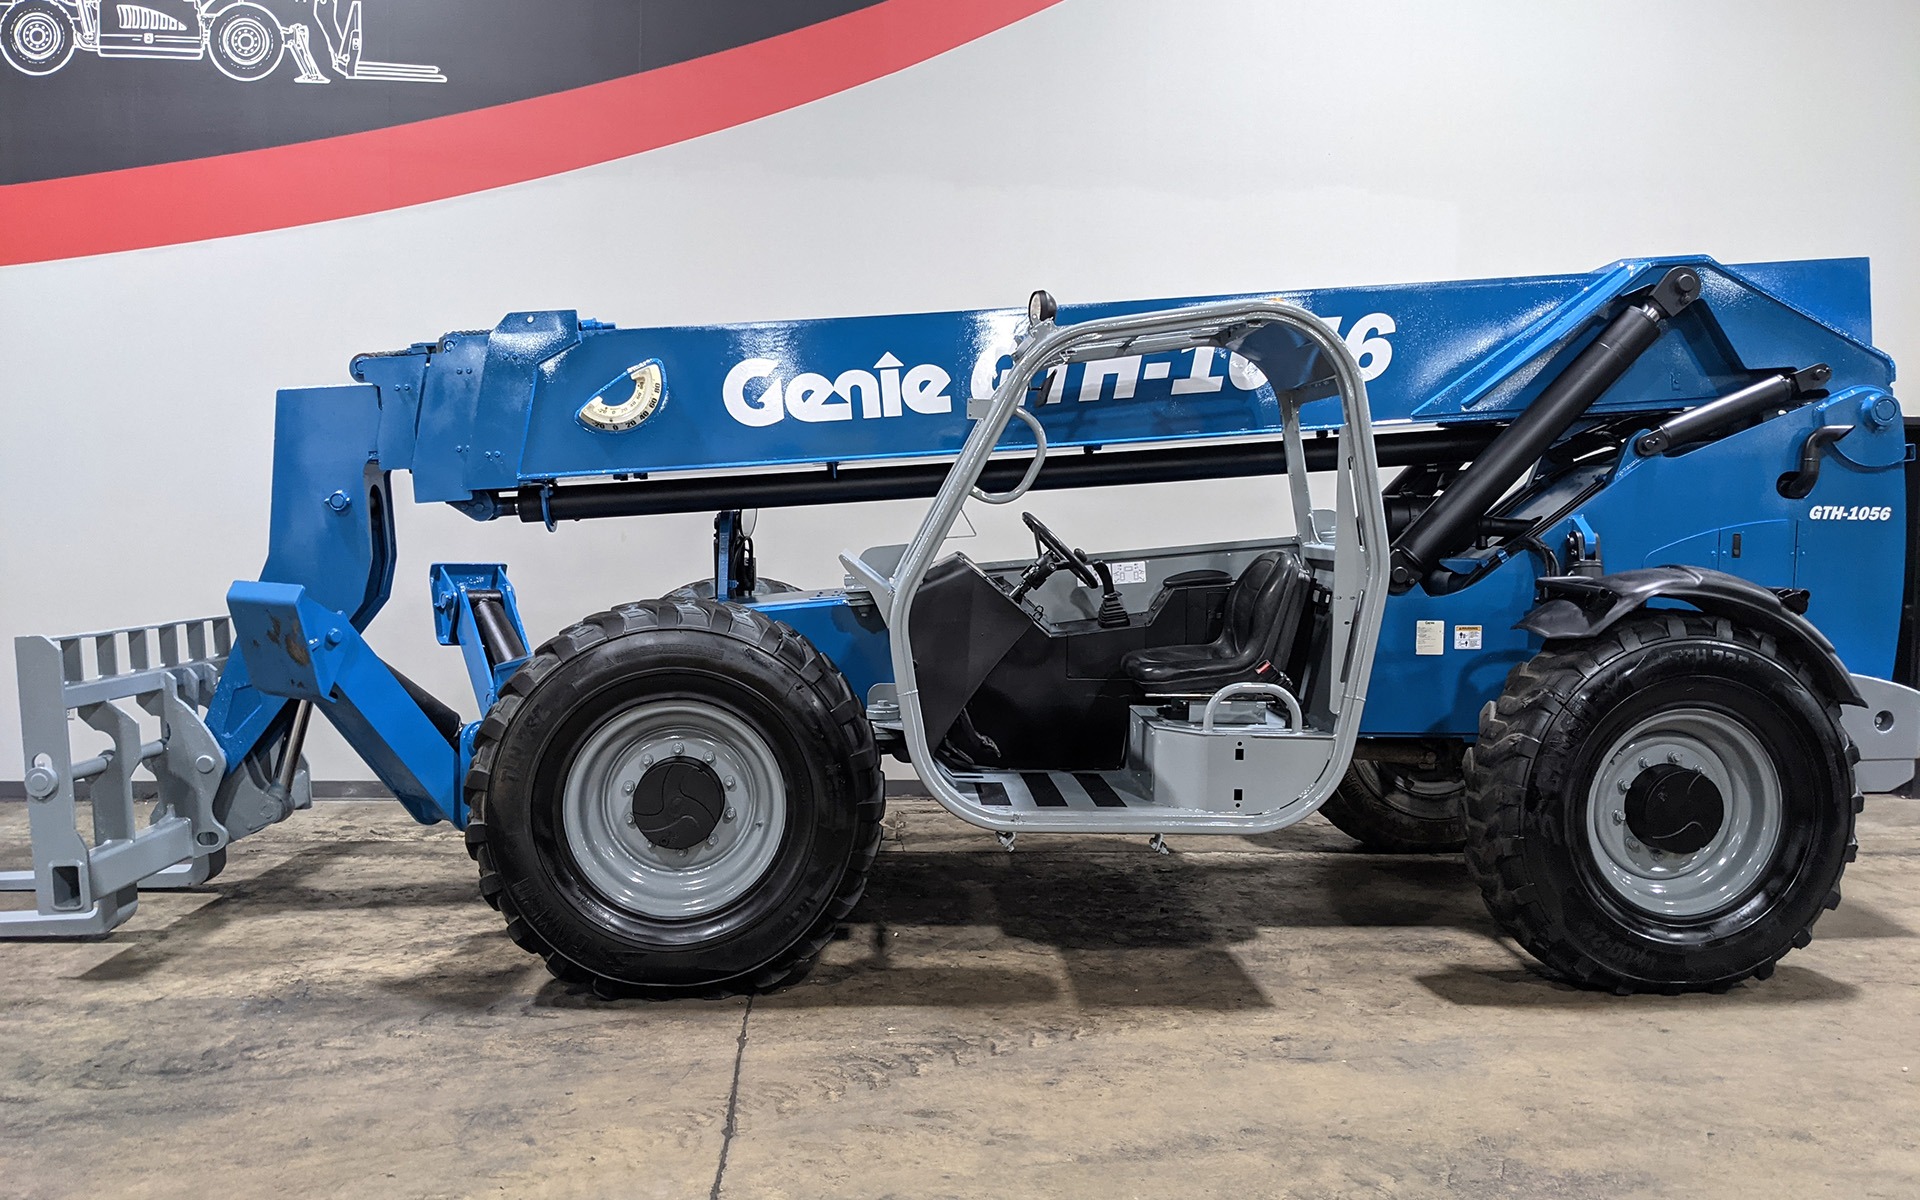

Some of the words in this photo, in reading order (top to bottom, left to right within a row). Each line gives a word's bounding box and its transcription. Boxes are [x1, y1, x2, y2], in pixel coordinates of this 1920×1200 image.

[722, 351, 951, 428] Genie
[970, 312, 1397, 405] GH-16
[625, 420, 637, 428] 20
[639, 410, 649, 421] 40
[649, 397, 658, 409] 60
[1809, 505, 1892, 521] GTH-1056
